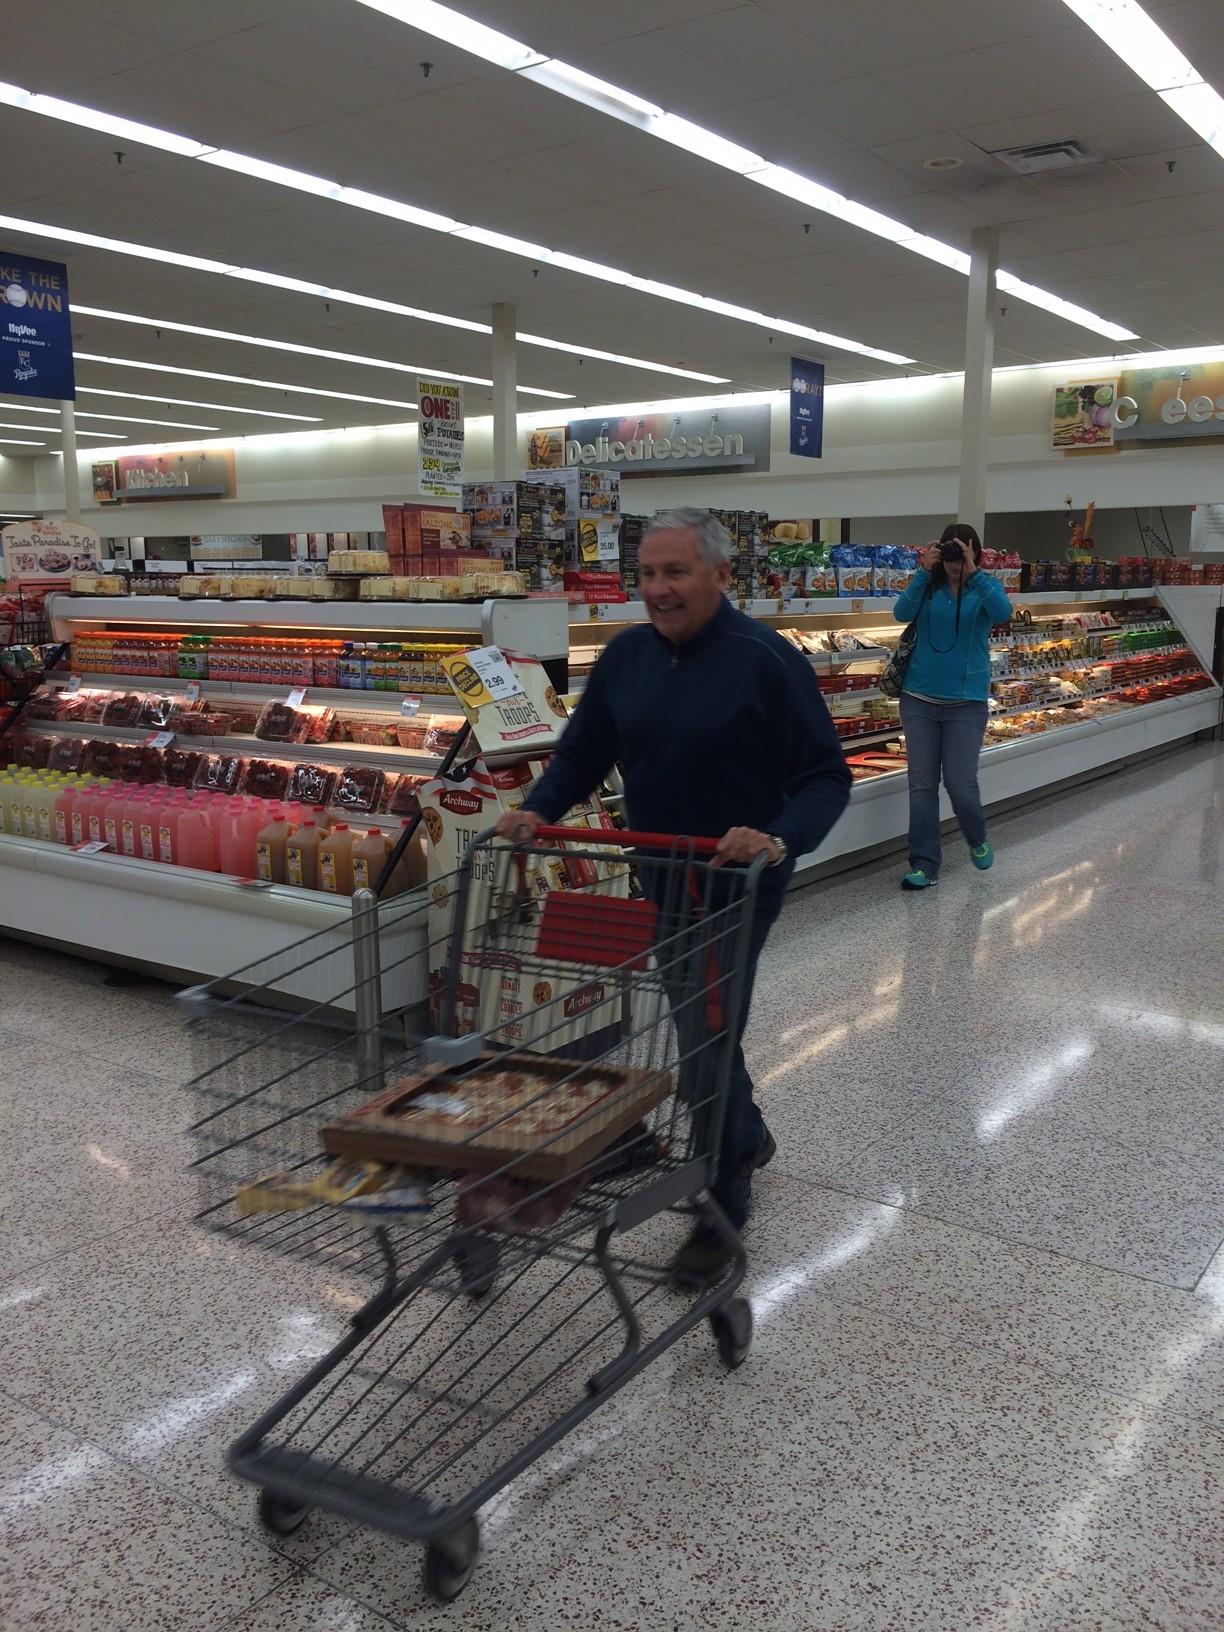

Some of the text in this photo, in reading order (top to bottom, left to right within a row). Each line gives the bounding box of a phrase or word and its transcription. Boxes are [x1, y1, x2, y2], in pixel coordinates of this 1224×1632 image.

[28, 272, 61, 290] THE
[421, 396, 450, 420] ONE
[566, 432, 744, 466] Delicatessen
[125, 466, 189, 490] Kitchen
[6, 536, 33, 549] Taste
[31, 534, 72, 547] Paradise
[70, 535, 82, 548] To
[600, 542, 615, 551] 35.00
[485, 675, 505, 689] 2.99
[495, 701, 541, 727] TROOPS
[442, 793, 480, 811] Archway
[455, 828, 493, 858] TRT
